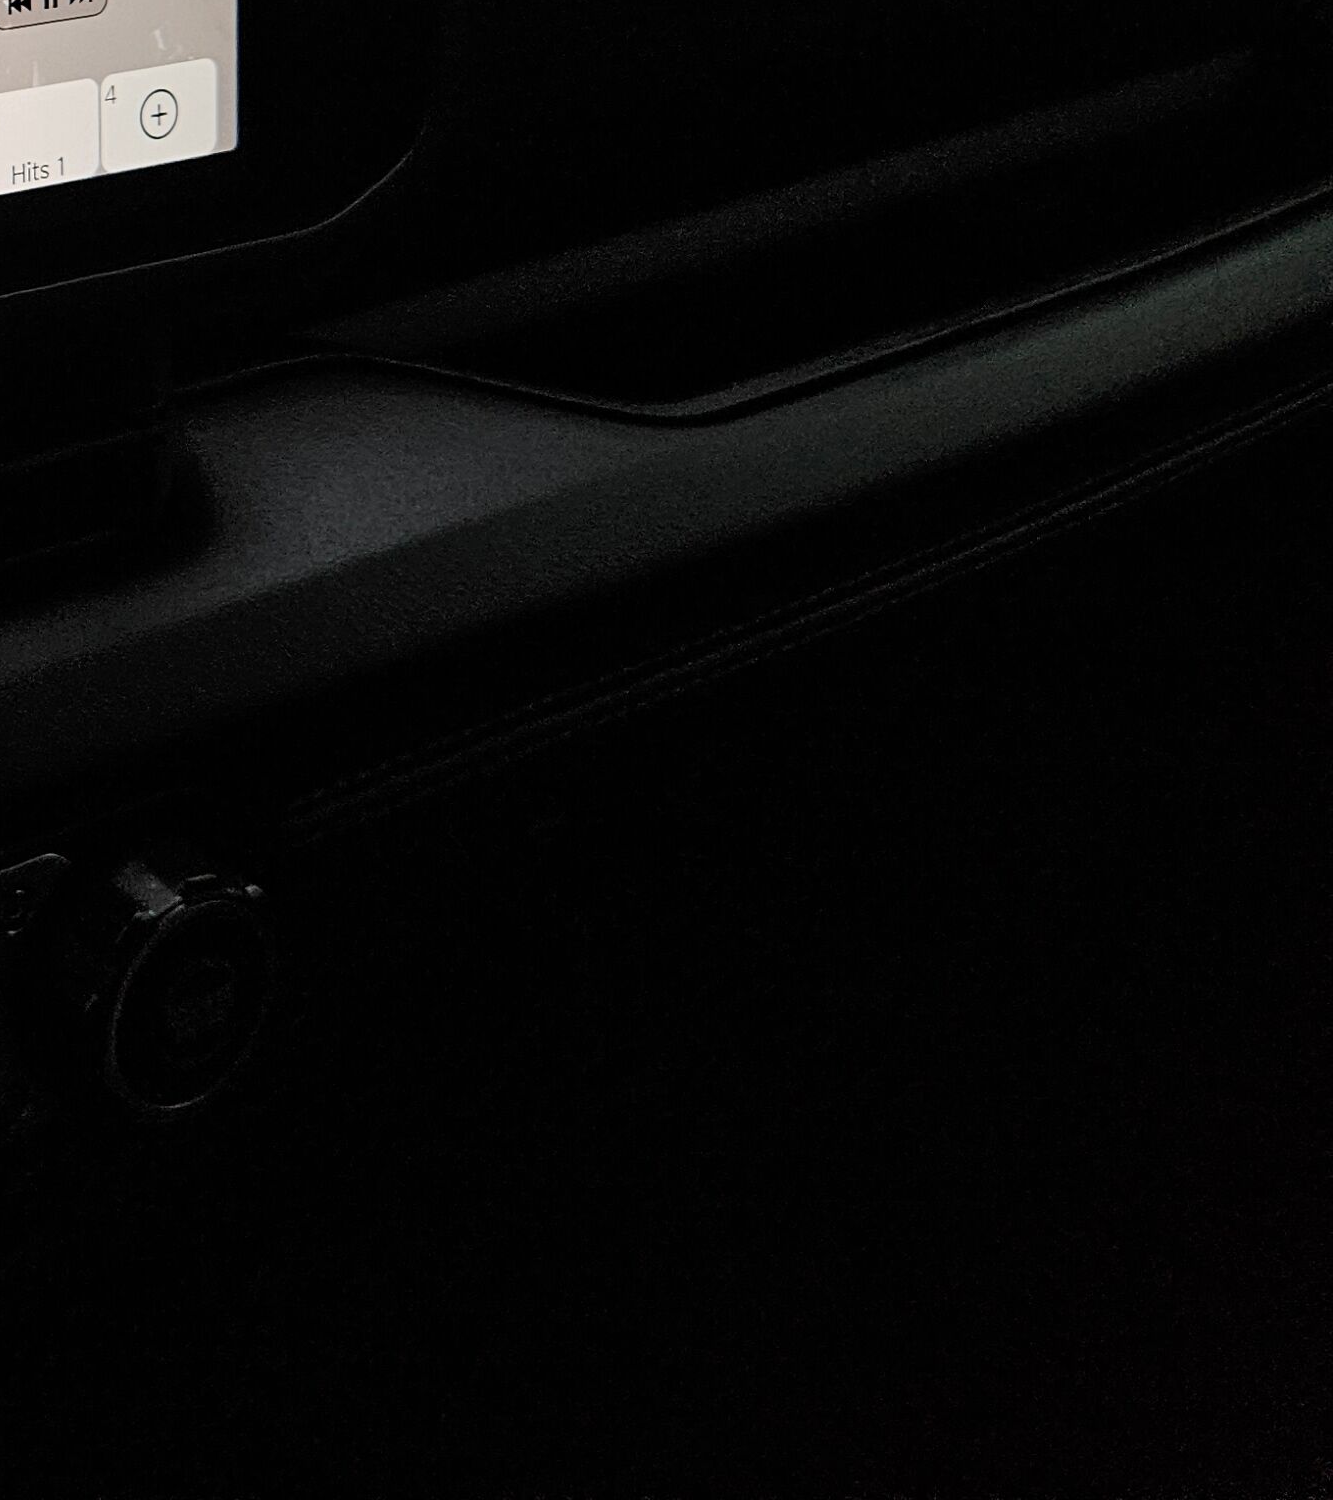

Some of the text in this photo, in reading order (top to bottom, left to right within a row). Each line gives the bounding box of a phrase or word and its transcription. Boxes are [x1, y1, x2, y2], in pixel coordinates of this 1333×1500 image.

[105, 86, 116, 103] 4
[11, 156, 65, 185] Hits 1
